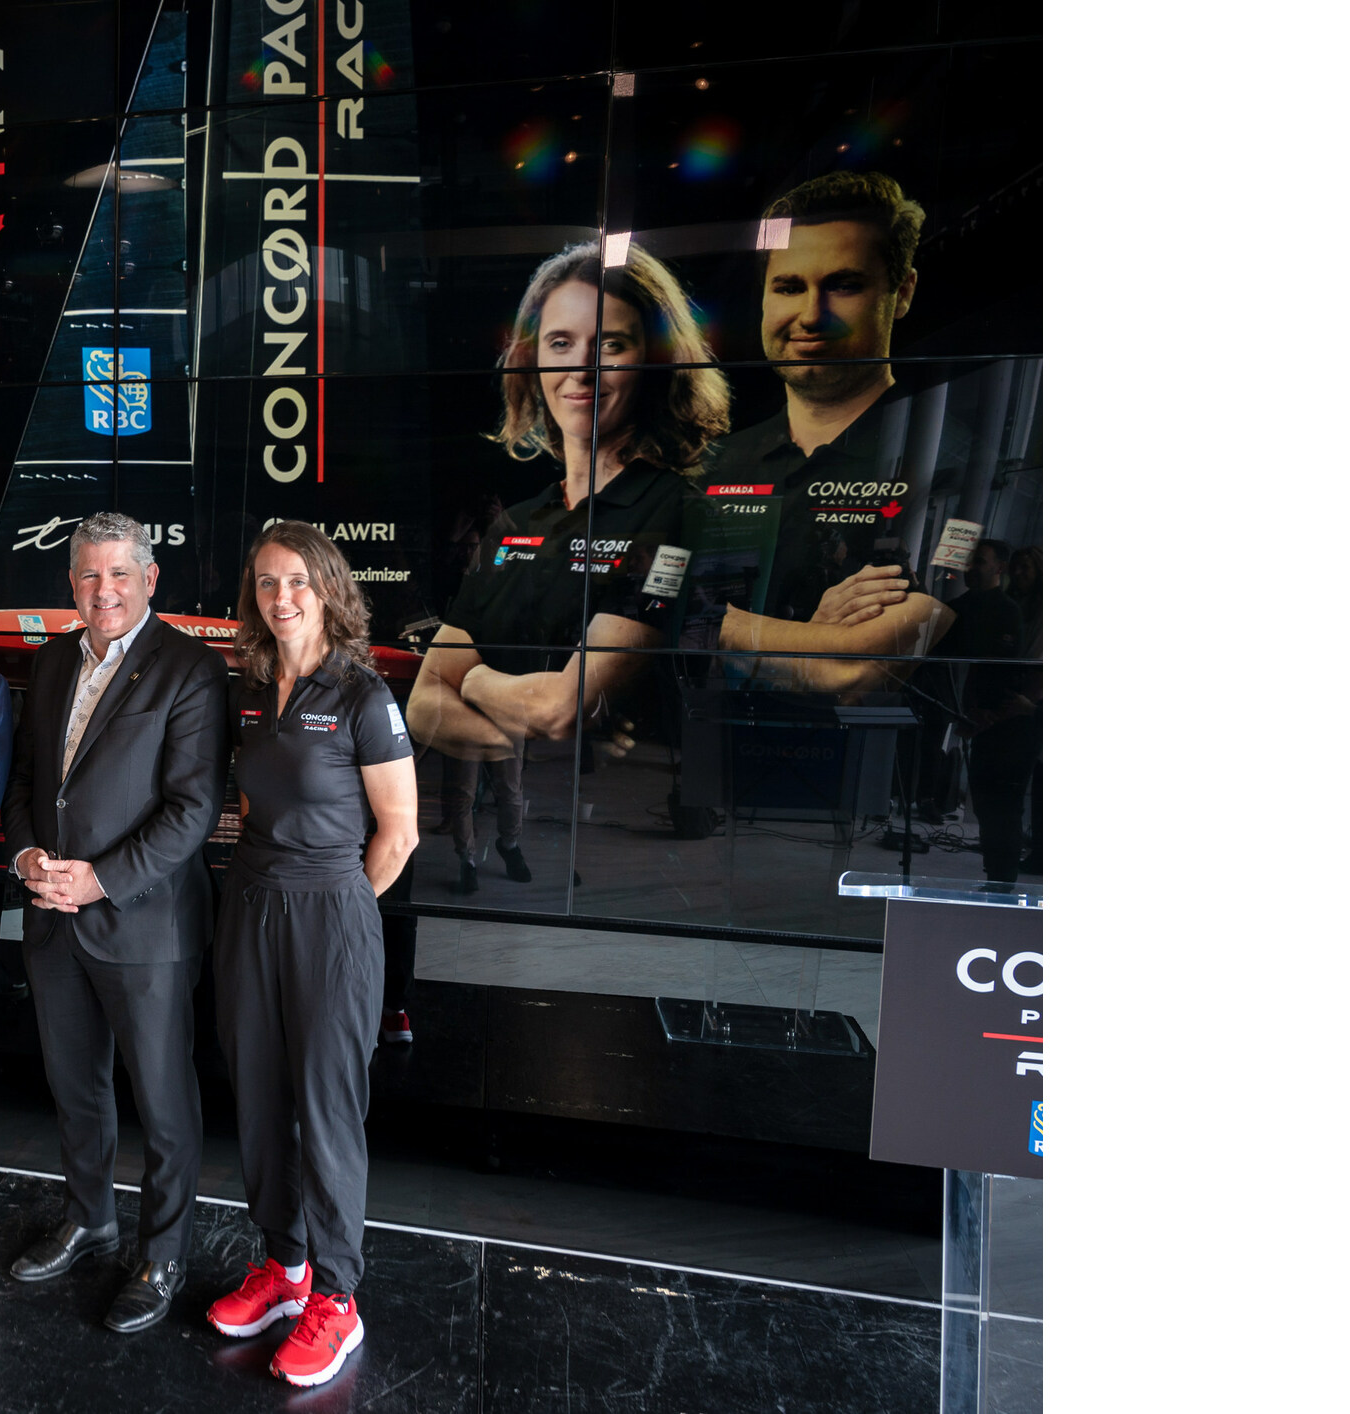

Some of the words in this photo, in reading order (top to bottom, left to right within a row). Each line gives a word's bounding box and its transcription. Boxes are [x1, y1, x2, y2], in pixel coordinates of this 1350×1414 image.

[91, 409, 146, 430] RBC
[718, 485, 754, 494] CANADA
[820, 498, 881, 506] PACIFIC
[733, 505, 768, 514] TELUS
[815, 512, 876, 524] RACING
[350, 566, 411, 582] aximizer
